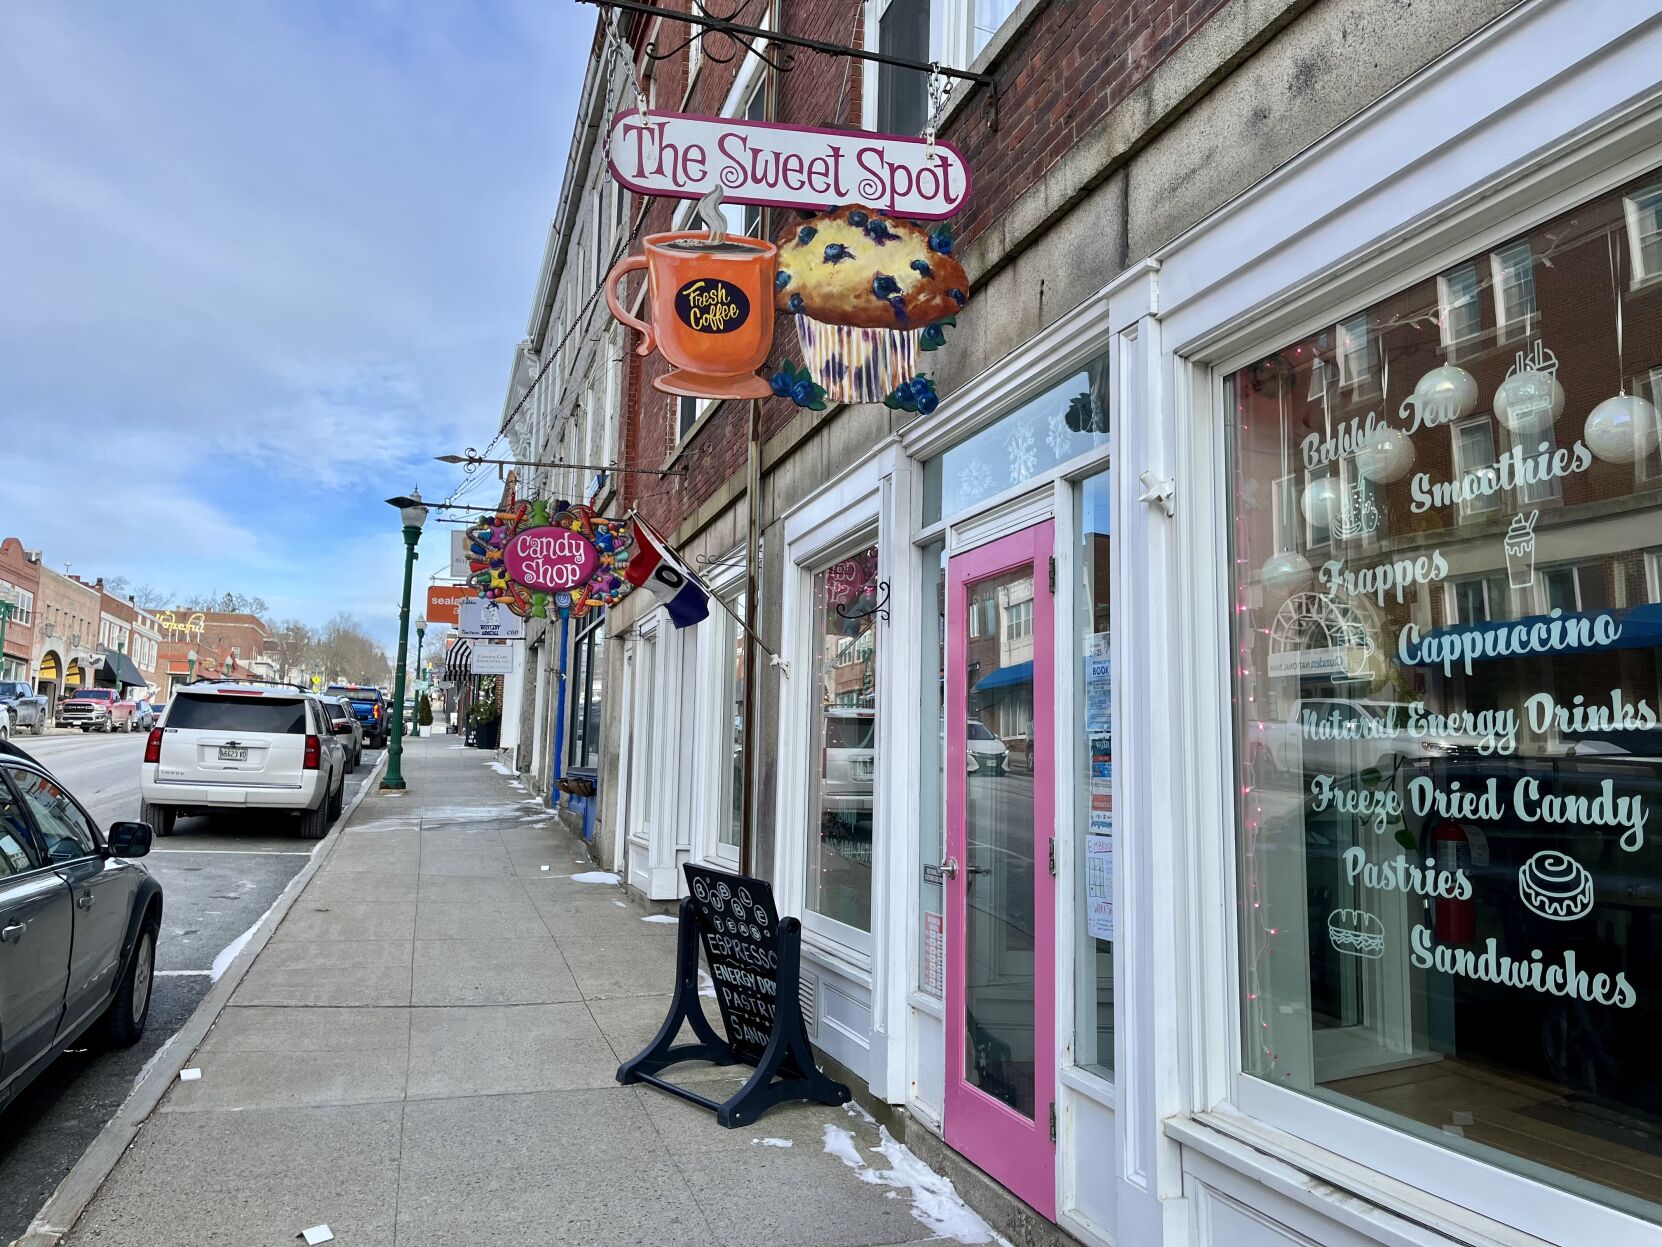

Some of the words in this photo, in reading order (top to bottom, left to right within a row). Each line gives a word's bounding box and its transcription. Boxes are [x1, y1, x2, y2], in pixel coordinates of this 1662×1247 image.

[623, 121, 707, 187] The
[717, 133, 850, 198] Sweet
[856, 147, 960, 210] Spot
[683, 281, 731, 308] Fresh
[690, 296, 739, 331] Coffee
[1300, 411, 1393, 469] Bubble
[1398, 392, 1462, 436] Tea
[1410, 439, 1592, 514] Smoothies
[517, 534, 585, 563] Candy
[521, 559, 580, 587] Shop
[1318, 549, 1449, 607] Frappes
[1399, 607, 1622, 678] Cappuccino
[1301, 703, 1401, 741] Natural
[1407, 700, 1519, 756] Energy
[1523, 688, 1657, 734] Drinks
[1310, 774, 1404, 835] Freeze
[1407, 775, 1505, 820] Dried
[1512, 776, 1649, 852] Candy
[1342, 846, 1473, 901] Pastries
[713, 963, 756, 991] ENERGY
[1410, 923, 1637, 1009] Sandwiches
[730, 1014, 770, 1047] SAND
